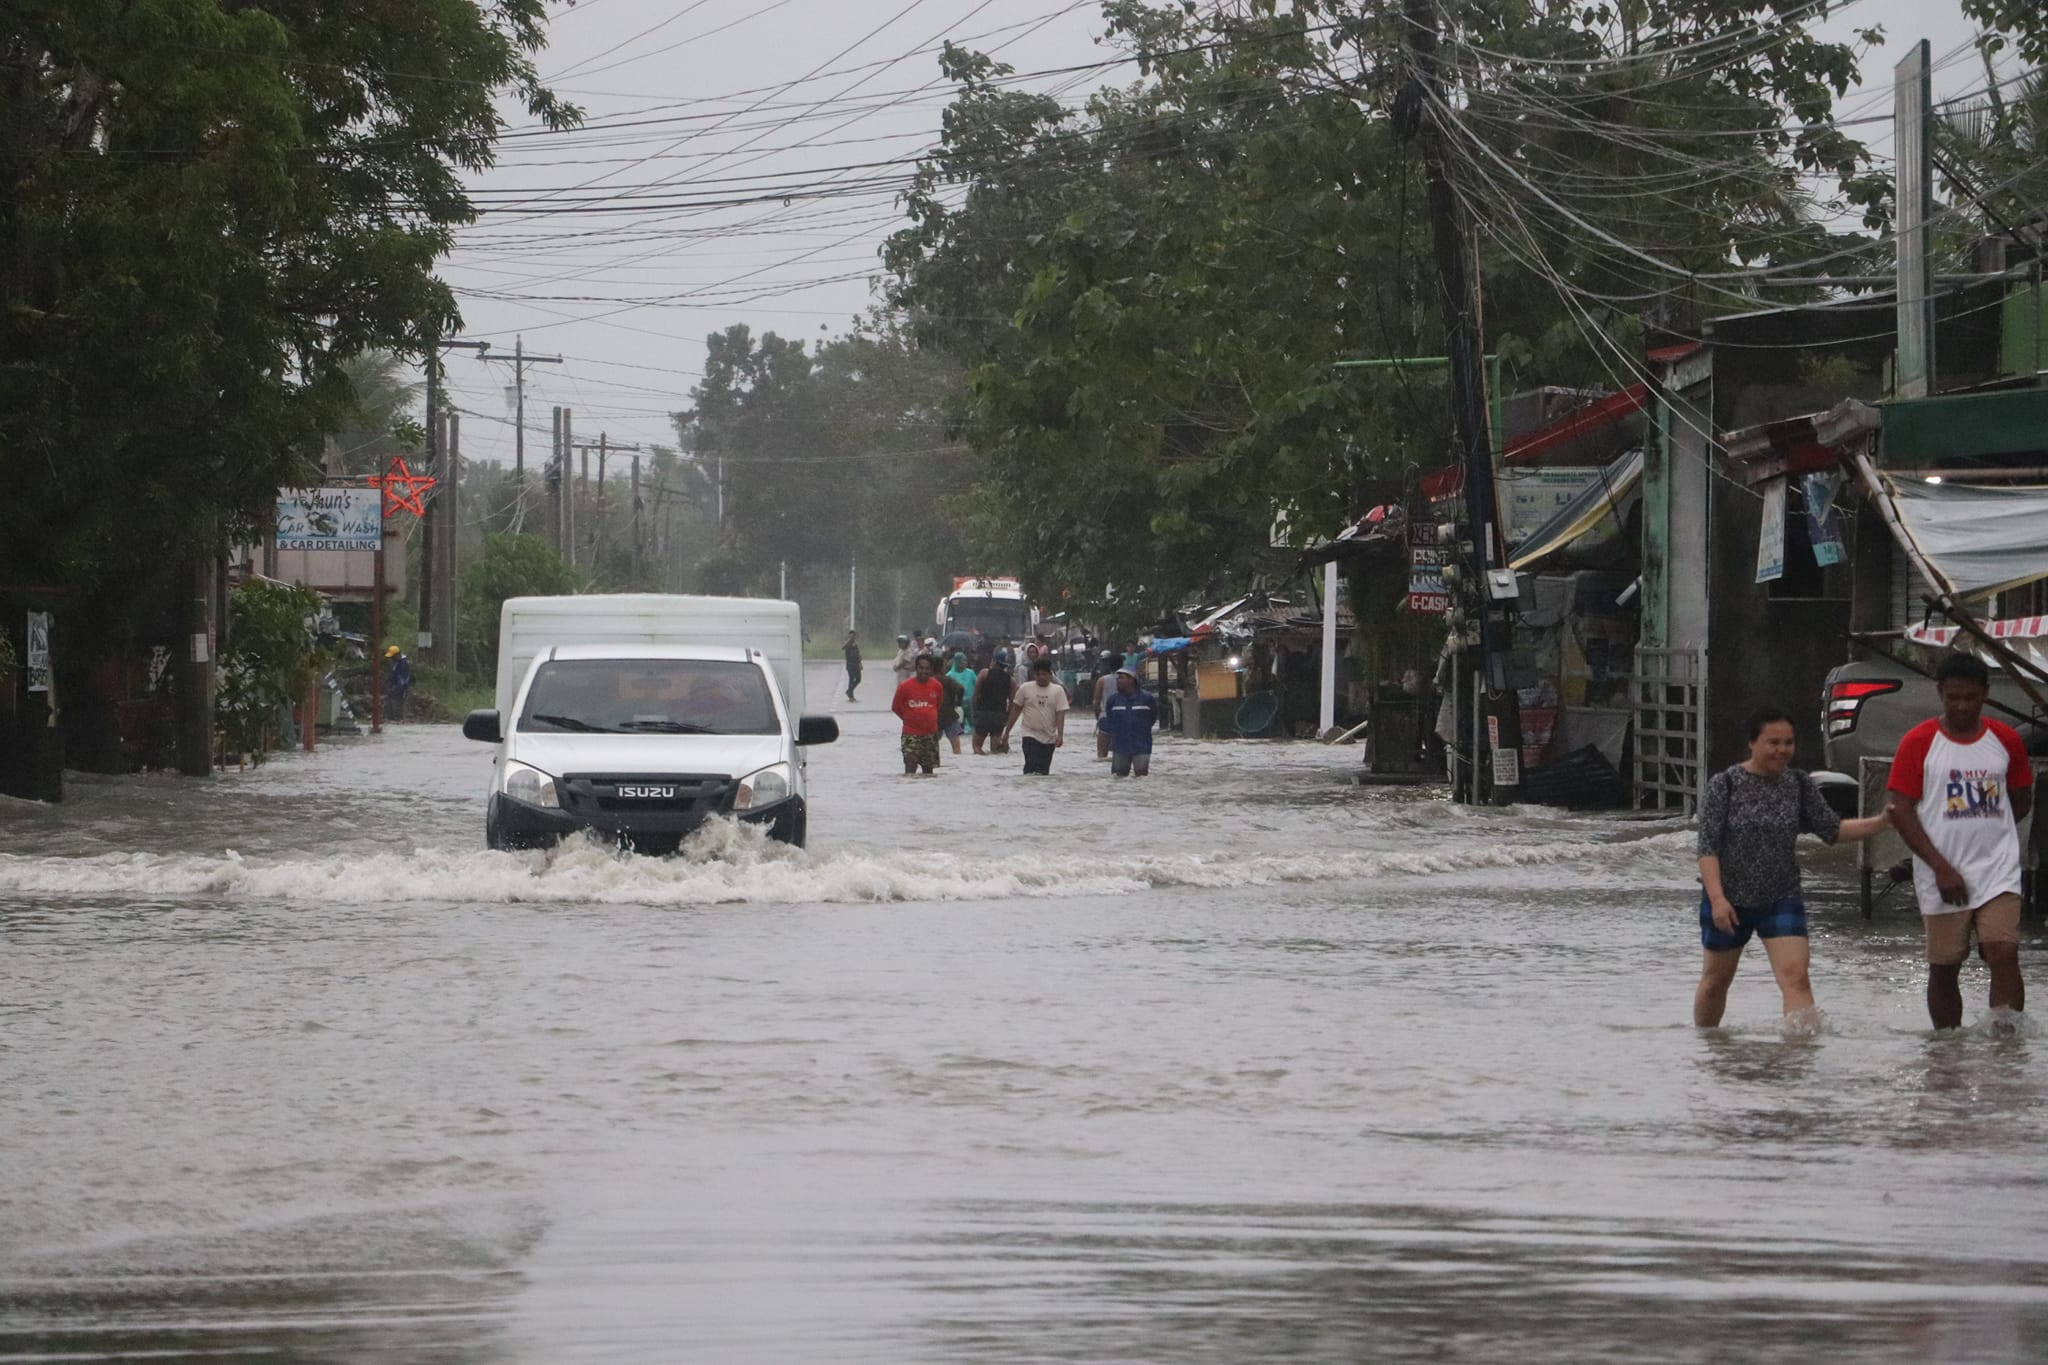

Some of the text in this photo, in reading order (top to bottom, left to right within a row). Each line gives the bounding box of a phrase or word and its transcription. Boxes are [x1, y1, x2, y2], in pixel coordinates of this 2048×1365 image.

[342, 521, 379, 534] WASH
[280, 540, 376, 550] & CAR DETAILING
[1411, 595, 1449, 611] G-CASH
[1965, 769, 1987, 778] HIV
[619, 787, 674, 797] ISUZU
